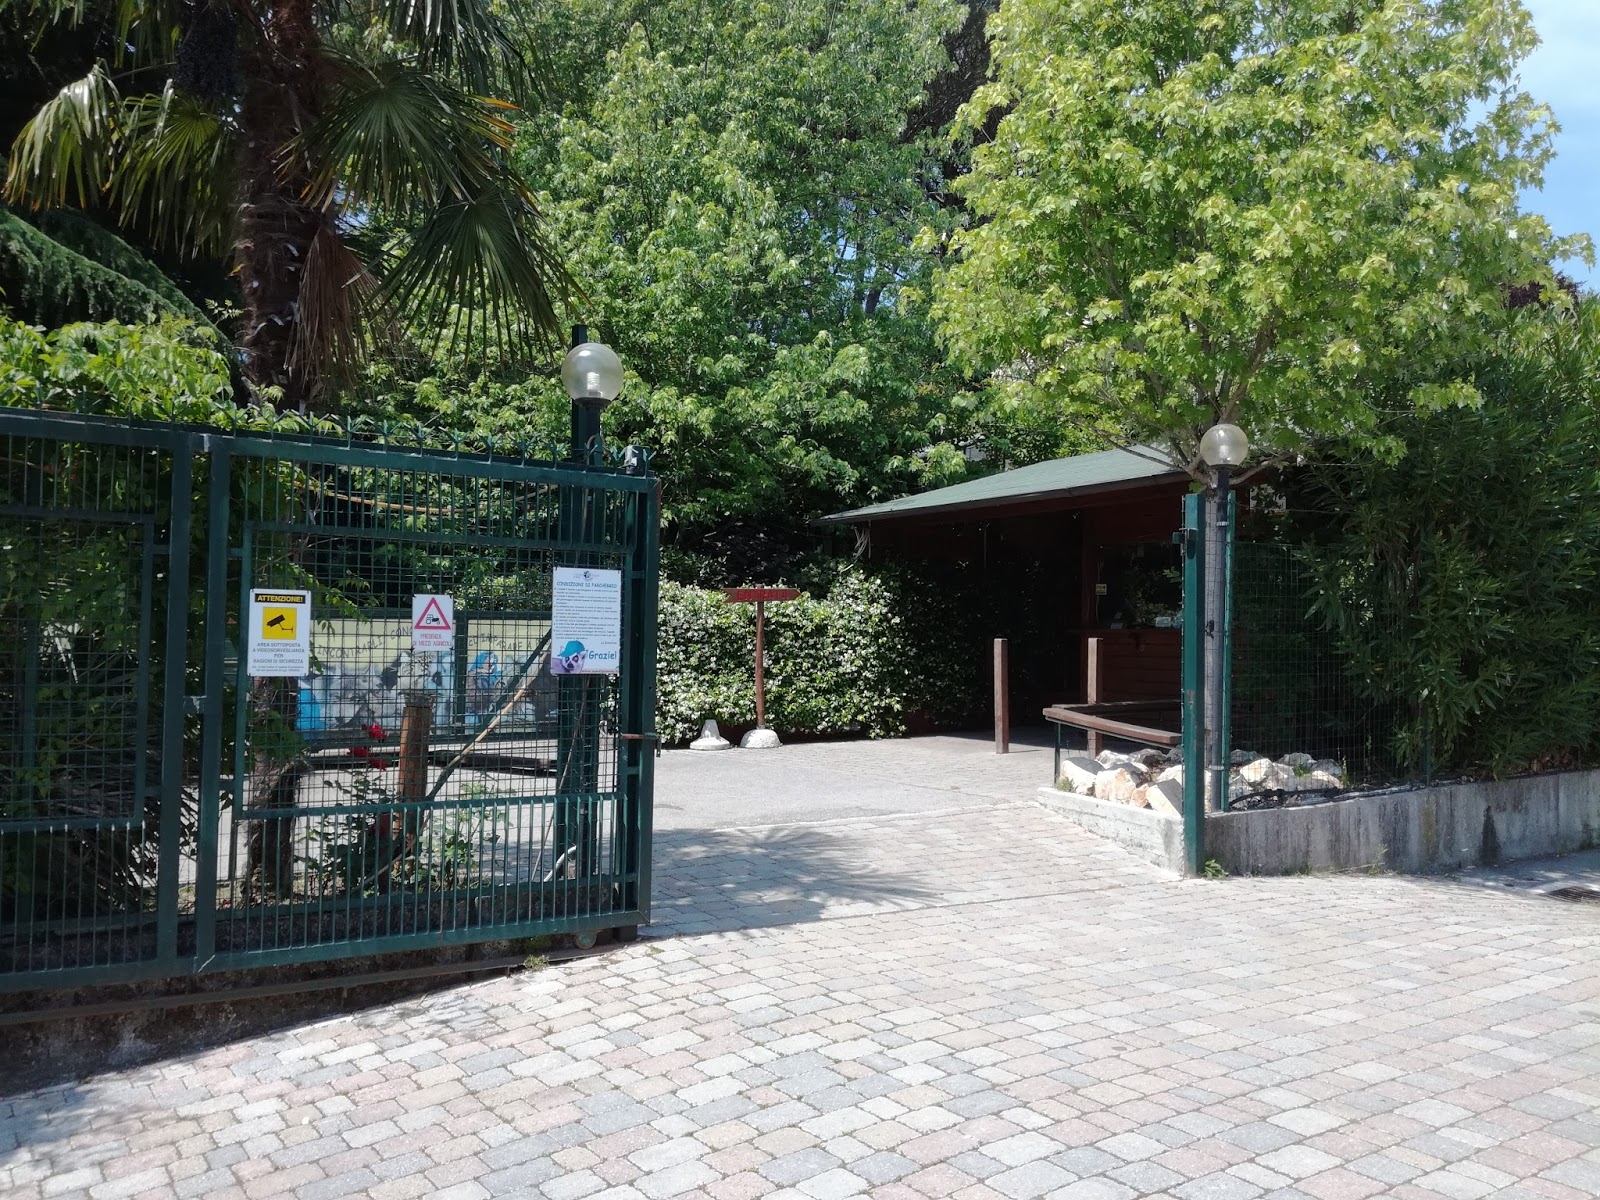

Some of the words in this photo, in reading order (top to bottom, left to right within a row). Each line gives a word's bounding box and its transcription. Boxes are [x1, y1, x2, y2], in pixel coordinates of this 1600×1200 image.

[257, 595, 304, 603] ATTENZIONE!
[737, 589, 788, 602] ENTRATA
[588, 650, 617, 660] Grazie!
